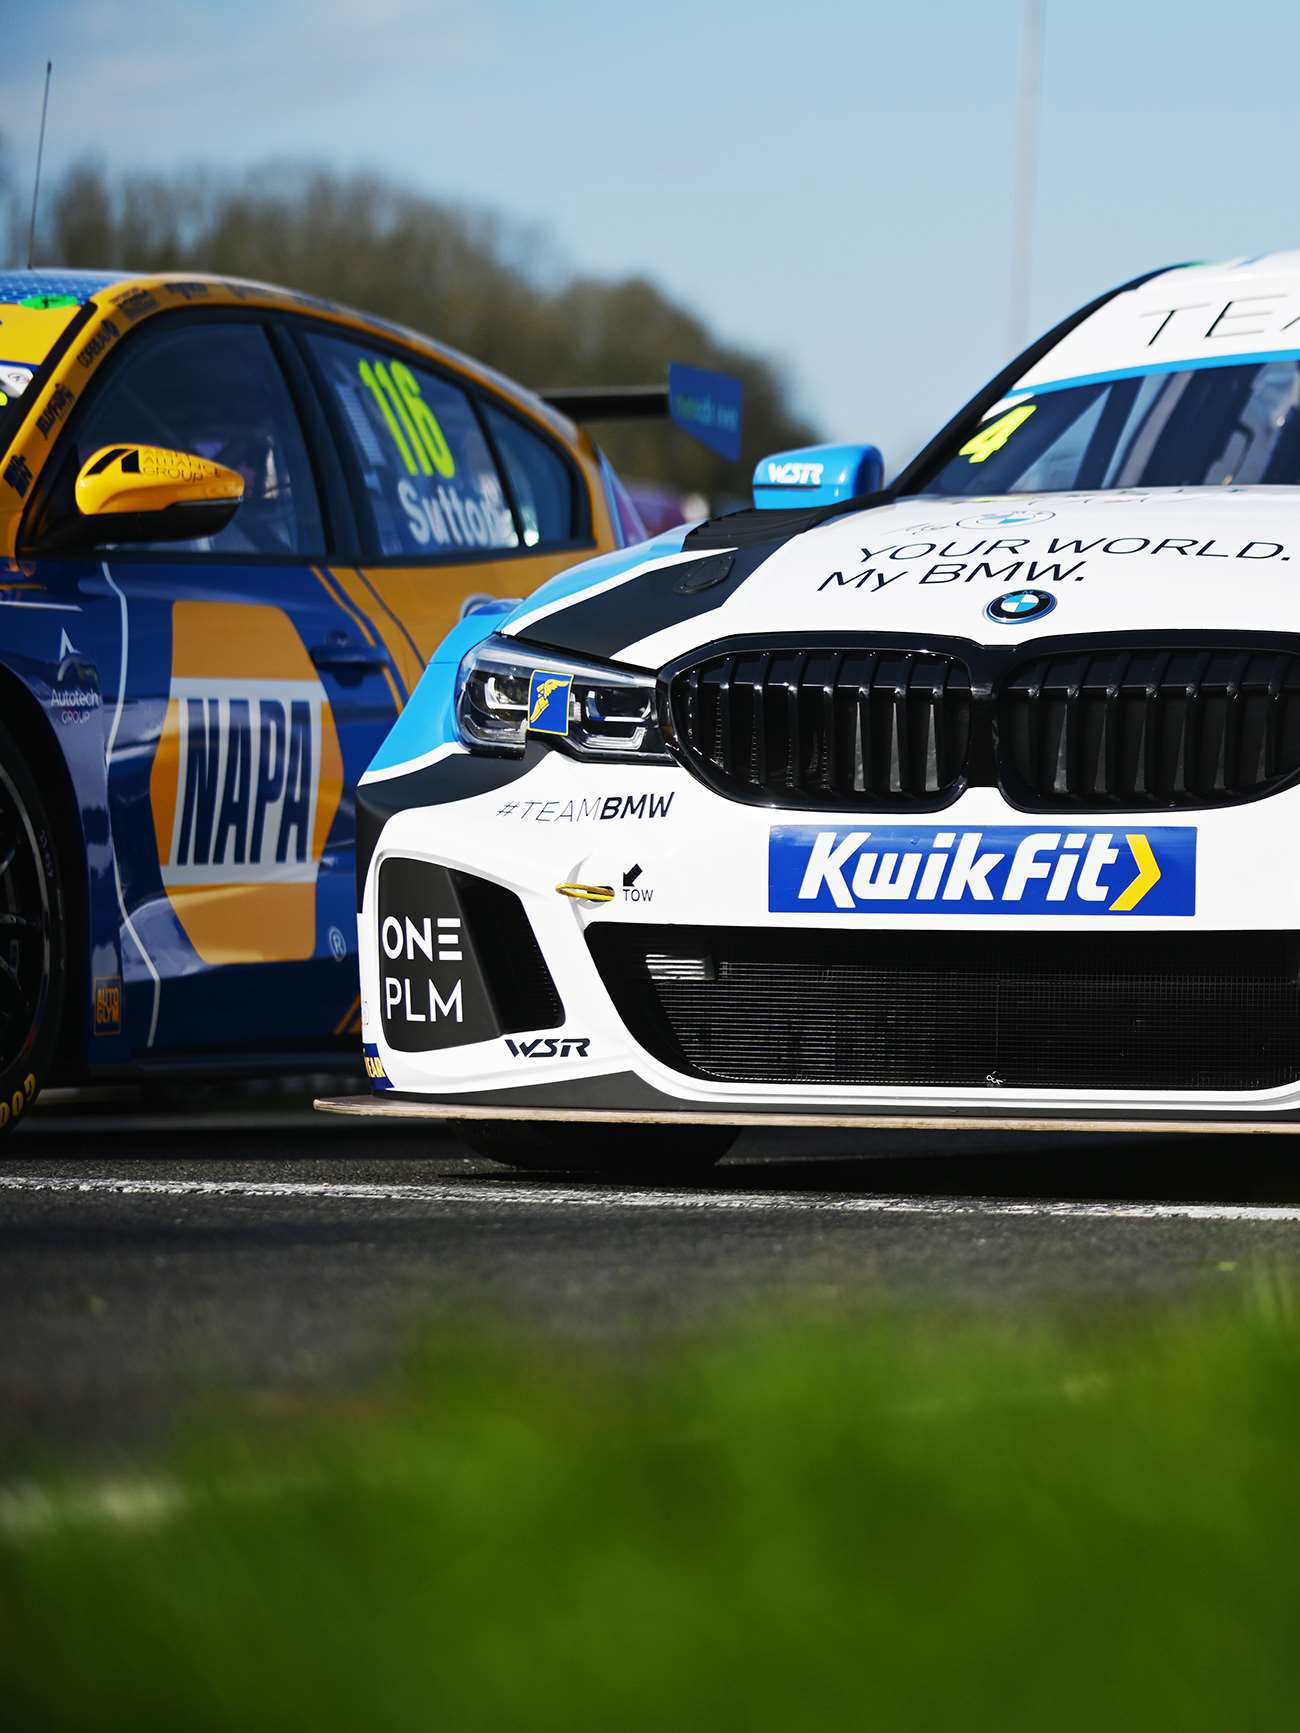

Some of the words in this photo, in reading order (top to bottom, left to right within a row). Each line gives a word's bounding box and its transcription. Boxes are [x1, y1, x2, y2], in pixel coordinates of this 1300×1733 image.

[359, 359, 456, 479] 116
[959, 405, 1038, 463] 4
[768, 462, 824, 485] WSR
[860, 538, 1031, 562] YOUR
[1047, 537, 1291, 562] WORLD.
[817, 568, 906, 593] My
[918, 560, 1086, 584] BMW.
[51, 688, 99, 706] Autotech
[176, 697, 313, 866] NAPA
[496, 791, 675, 823] #TEAMBMW
[623, 889, 654, 902] TOW
[382, 916, 463, 962] ONE
[385, 978, 464, 1023] PLM
[504, 1037, 591, 1059] WSR
